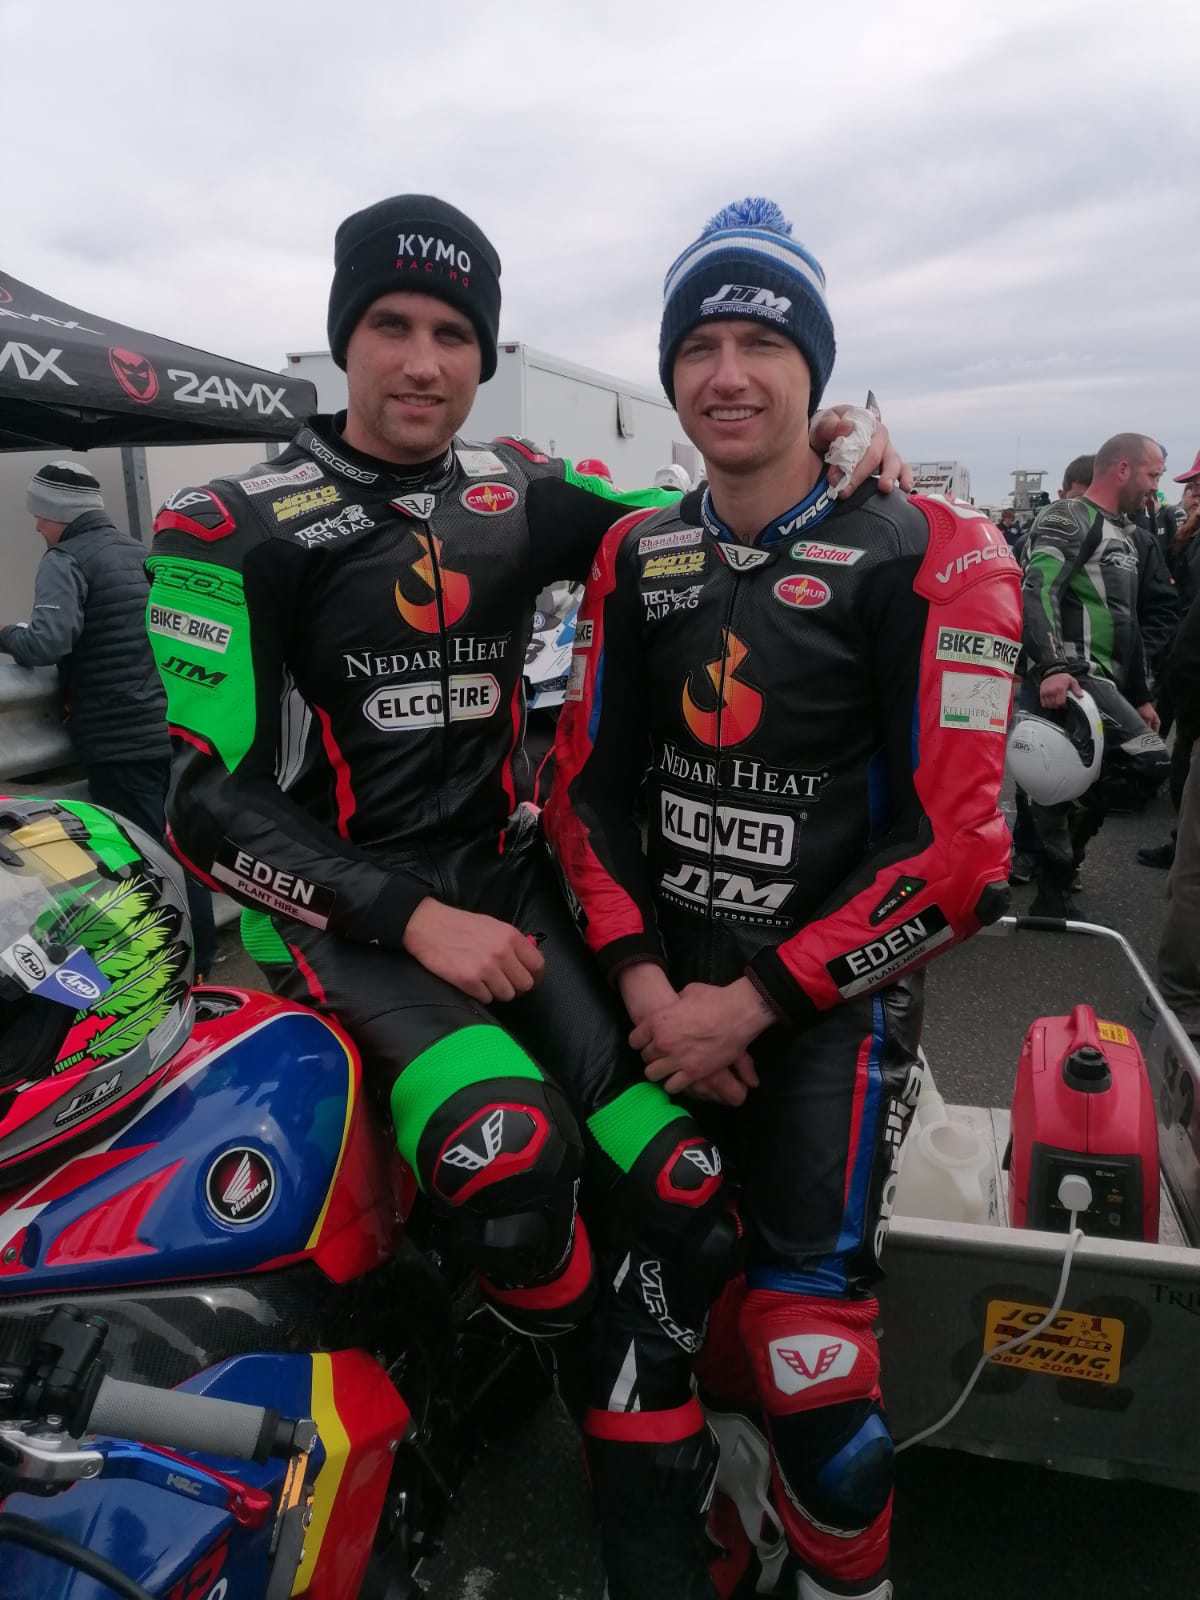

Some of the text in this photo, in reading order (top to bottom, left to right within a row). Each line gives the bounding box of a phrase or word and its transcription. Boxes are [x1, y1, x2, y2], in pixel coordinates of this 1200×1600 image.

[397, 233, 471, 273] KYMO
[395, 259, 469, 287] RACING
[702, 284, 792, 313] JTM
[310, 438, 379, 484] VIRCOS
[272, 485, 337, 512] MOTO
[468, 491, 515, 505] CREMUR
[294, 518, 334, 541] TECH
[778, 494, 831, 536] VIRC
[307, 518, 375, 548] AIR BAG
[645, 552, 705, 569] MOTO
[806, 545, 853, 562] Castrol
[642, 589, 675, 605] TECH
[781, 583, 825, 599] CREMUR
[647, 604, 669, 621] AIR
[161, 656, 229, 685] JTM
[343, 637, 509, 678] NEDAR HEAT
[660, 744, 821, 796] NEDAR HEAT
[665, 800, 785, 856] KLOVER
[234, 851, 315, 905] EDEN
[663, 864, 795, 909] JTM
[238, 880, 299, 917] PLANT HIRE
[715, 911, 791, 926] OTORSPORT
[845, 917, 928, 976] EDEN
[19, 949, 43, 978] Arai
[868, 961, 901, 985] PLANT
[61, 972, 98, 997] Arai
[58, 1073, 121, 1119] JTM
[230, 1178, 269, 1216] Honda
[1002, 1310, 1074, 1331] JOG
